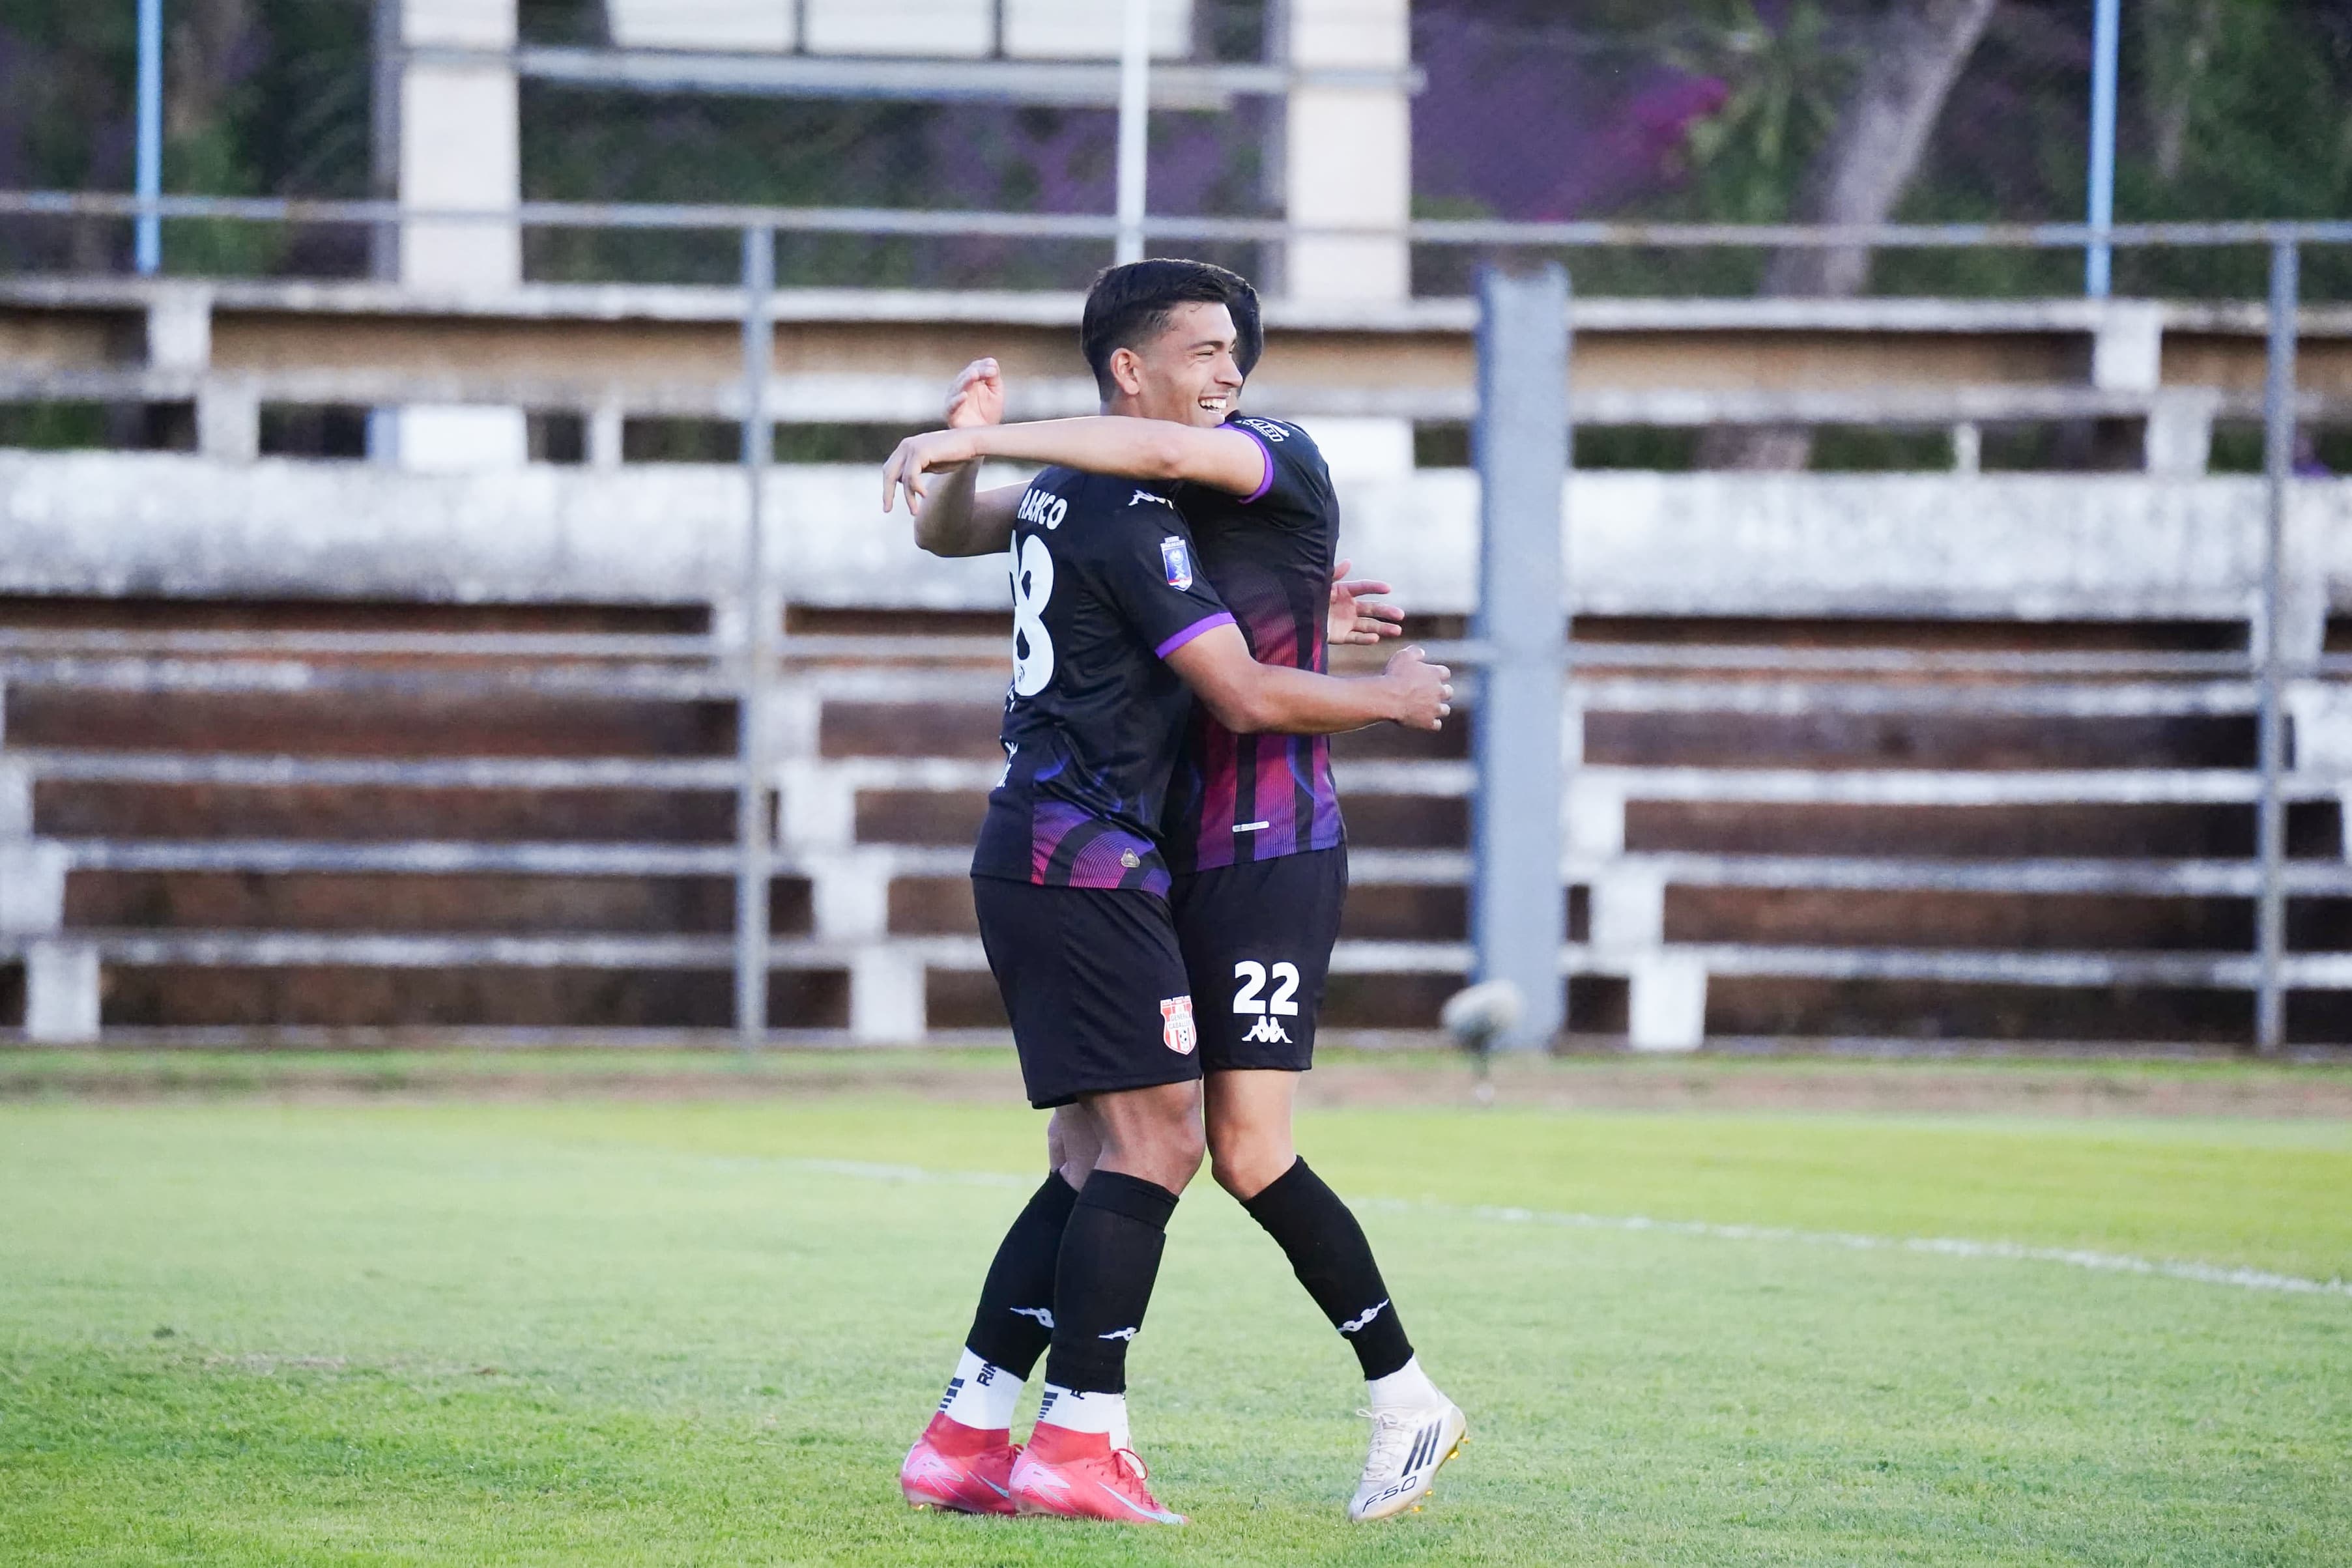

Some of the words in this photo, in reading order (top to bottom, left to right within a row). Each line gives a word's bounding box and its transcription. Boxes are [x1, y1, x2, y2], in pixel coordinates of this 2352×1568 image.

[1009, 529, 1054, 696] 8
[1233, 960, 1300, 1016] 22
[1362, 1475, 1417, 1513] F50
